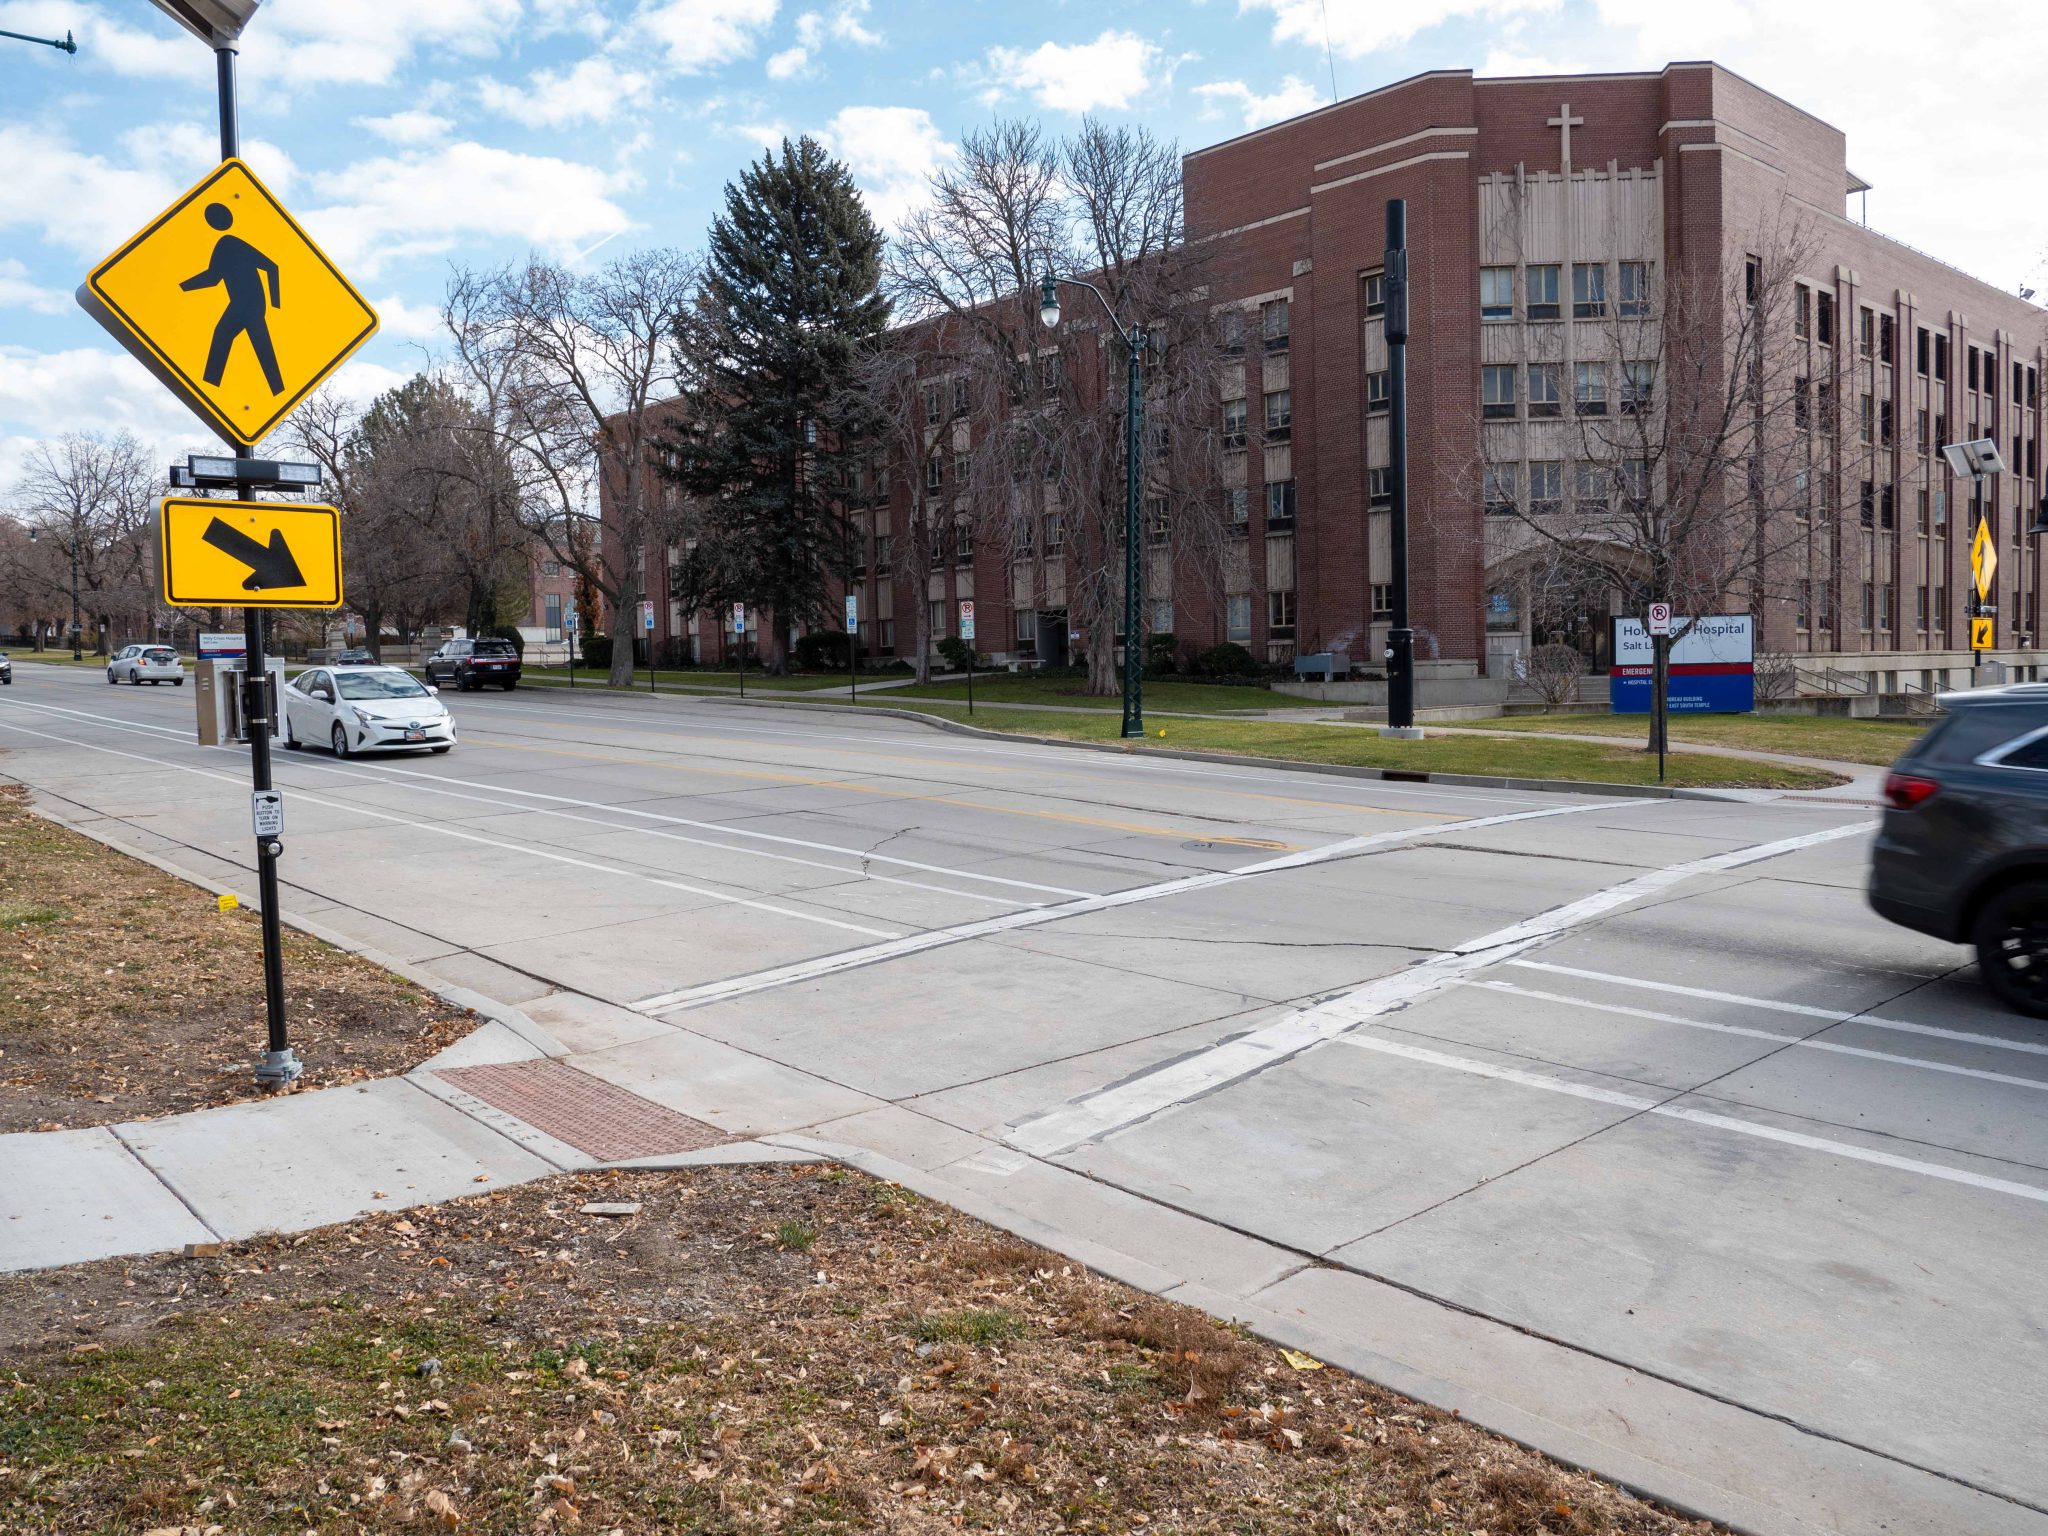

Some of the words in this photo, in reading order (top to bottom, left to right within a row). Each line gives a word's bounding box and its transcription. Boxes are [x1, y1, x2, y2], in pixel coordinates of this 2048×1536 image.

[1694, 623, 1744, 637] Hospital
[1623, 641, 1642, 650] Salt
[1622, 667, 1653, 676] EMERGEN
